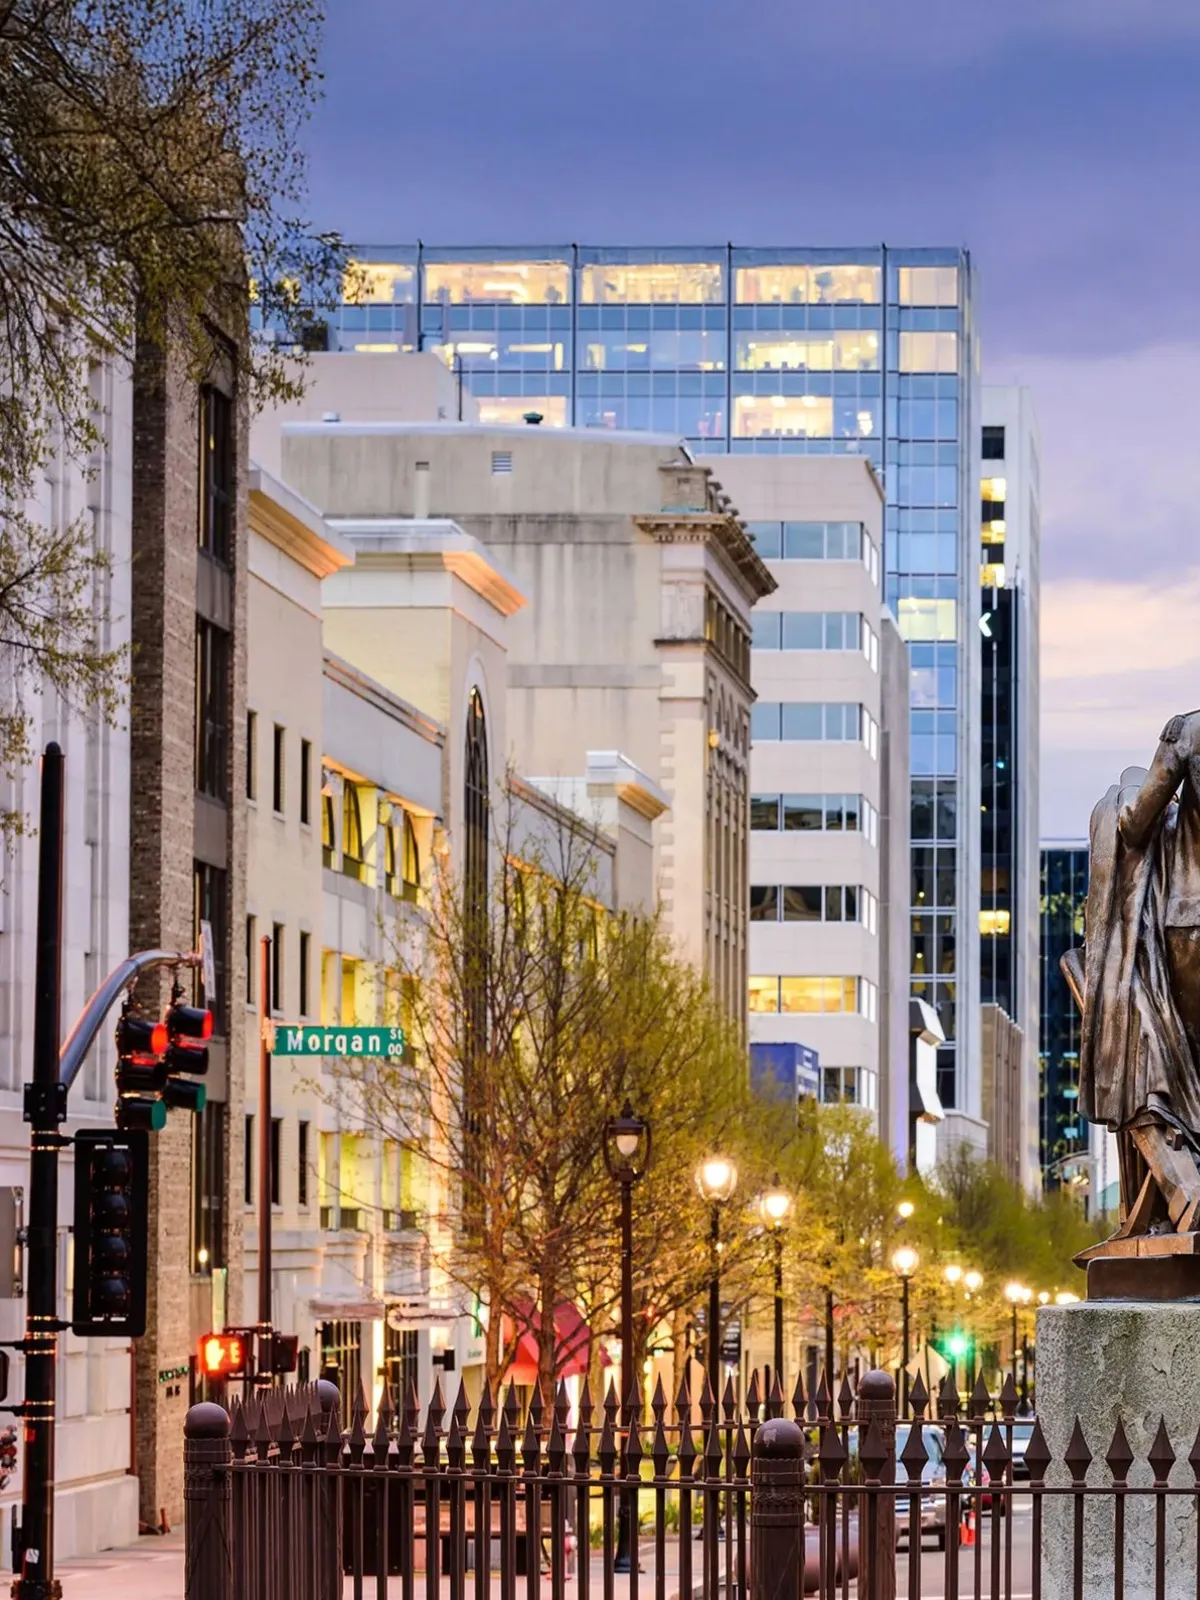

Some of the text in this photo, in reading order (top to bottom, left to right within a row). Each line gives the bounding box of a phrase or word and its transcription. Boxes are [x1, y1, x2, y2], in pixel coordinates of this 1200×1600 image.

[287, 1030, 380, 1054] Morgan
[390, 1028, 402, 1040] St
[387, 1043, 402, 1055] 00
